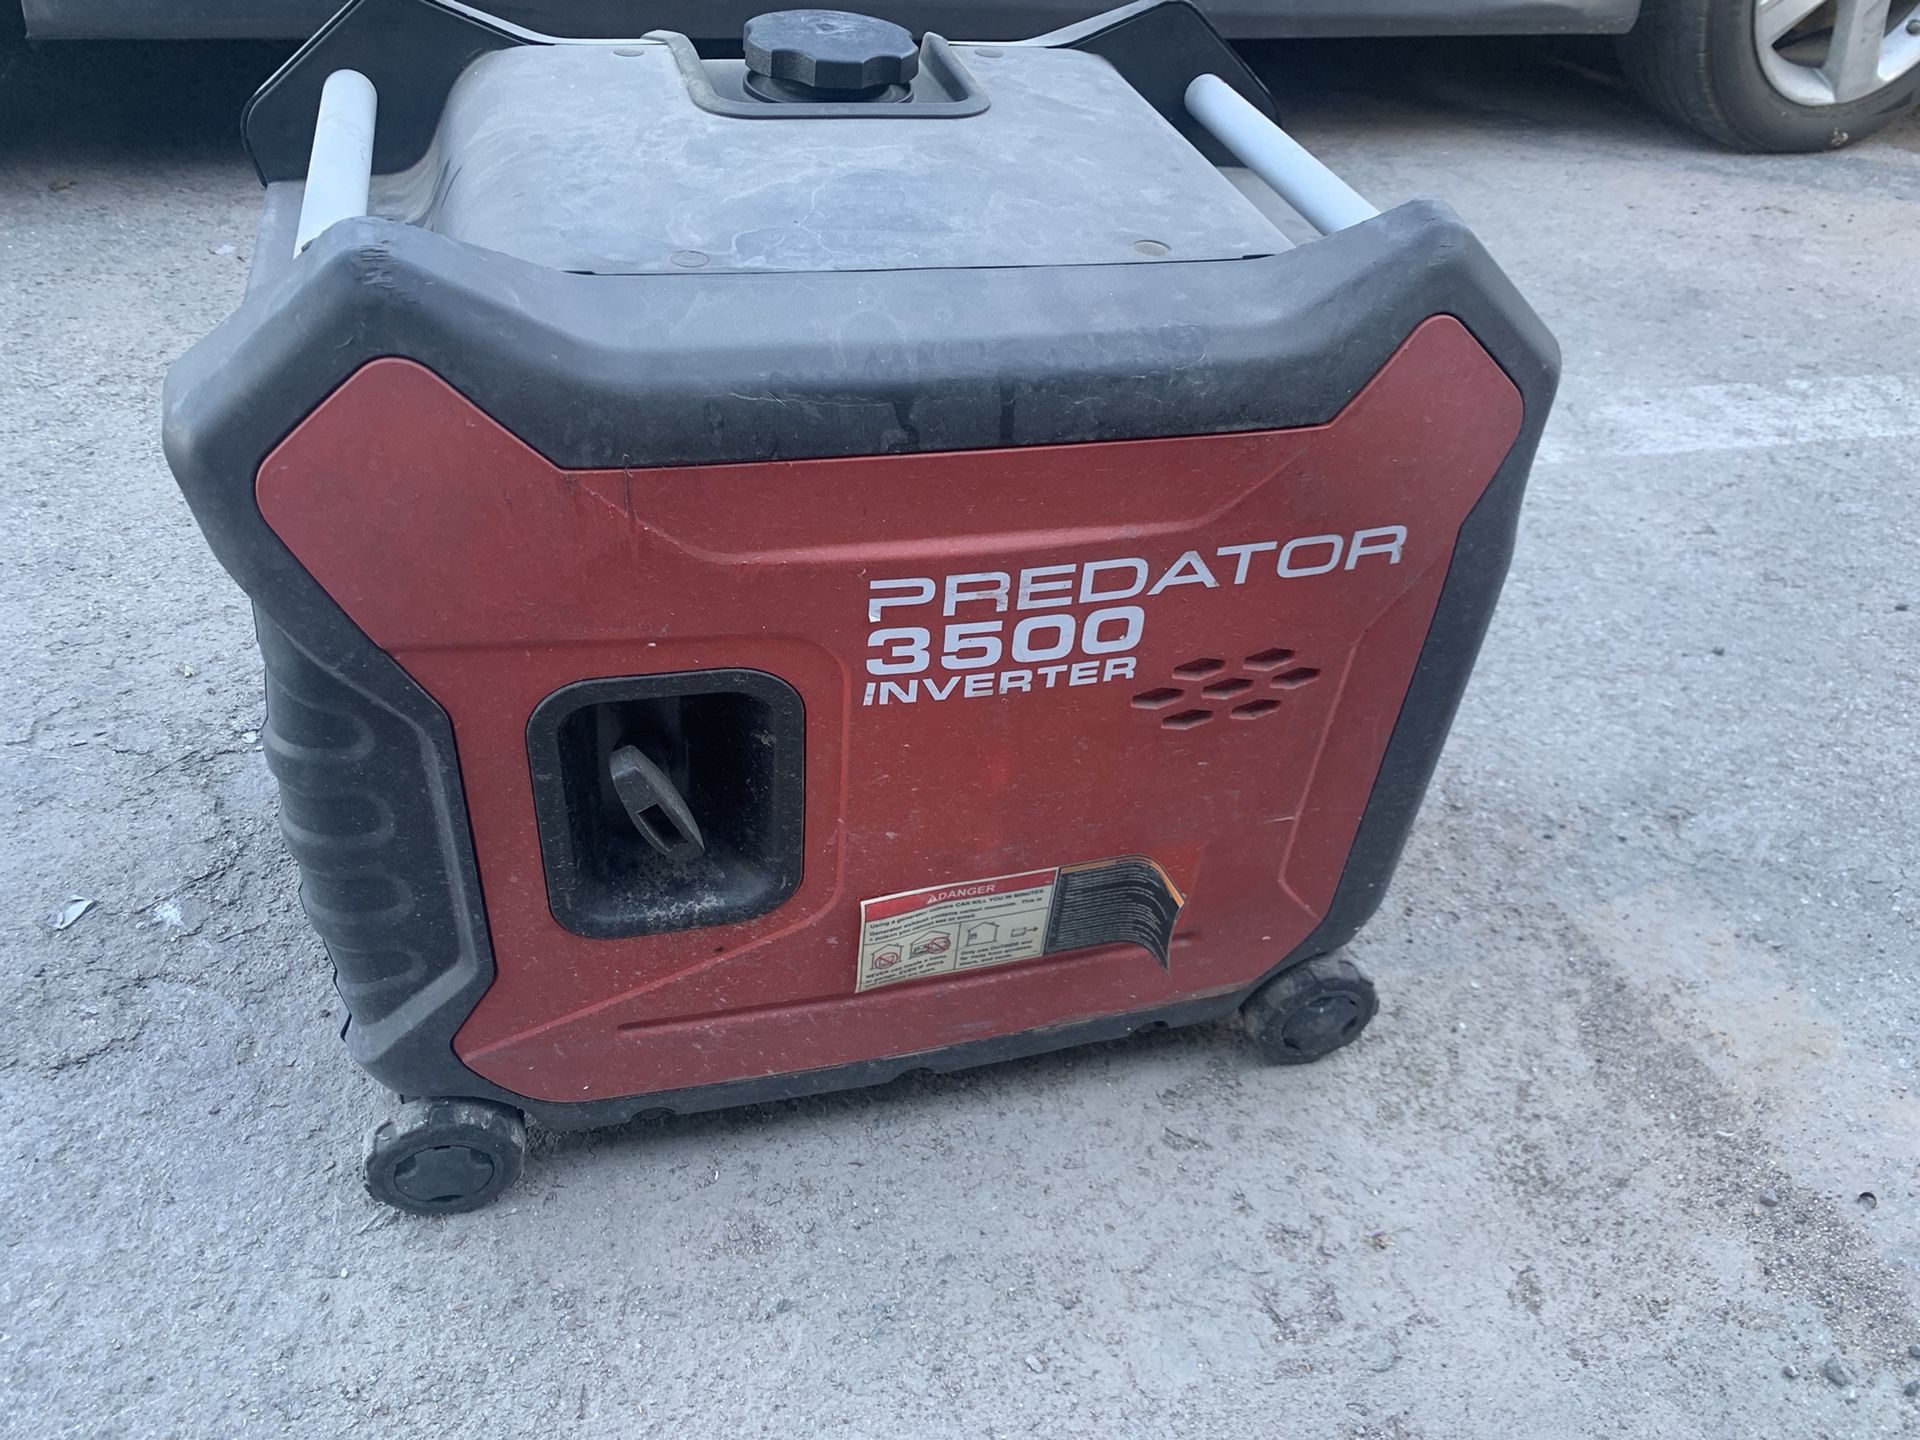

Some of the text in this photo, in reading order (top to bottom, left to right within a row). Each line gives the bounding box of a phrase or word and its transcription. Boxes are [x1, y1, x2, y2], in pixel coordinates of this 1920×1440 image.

[868, 524, 1408, 623] PREDATOR
[866, 605, 1145, 676] 3500
[862, 656, 1138, 707] INVERTER
[938, 884, 996, 900] DANGER
